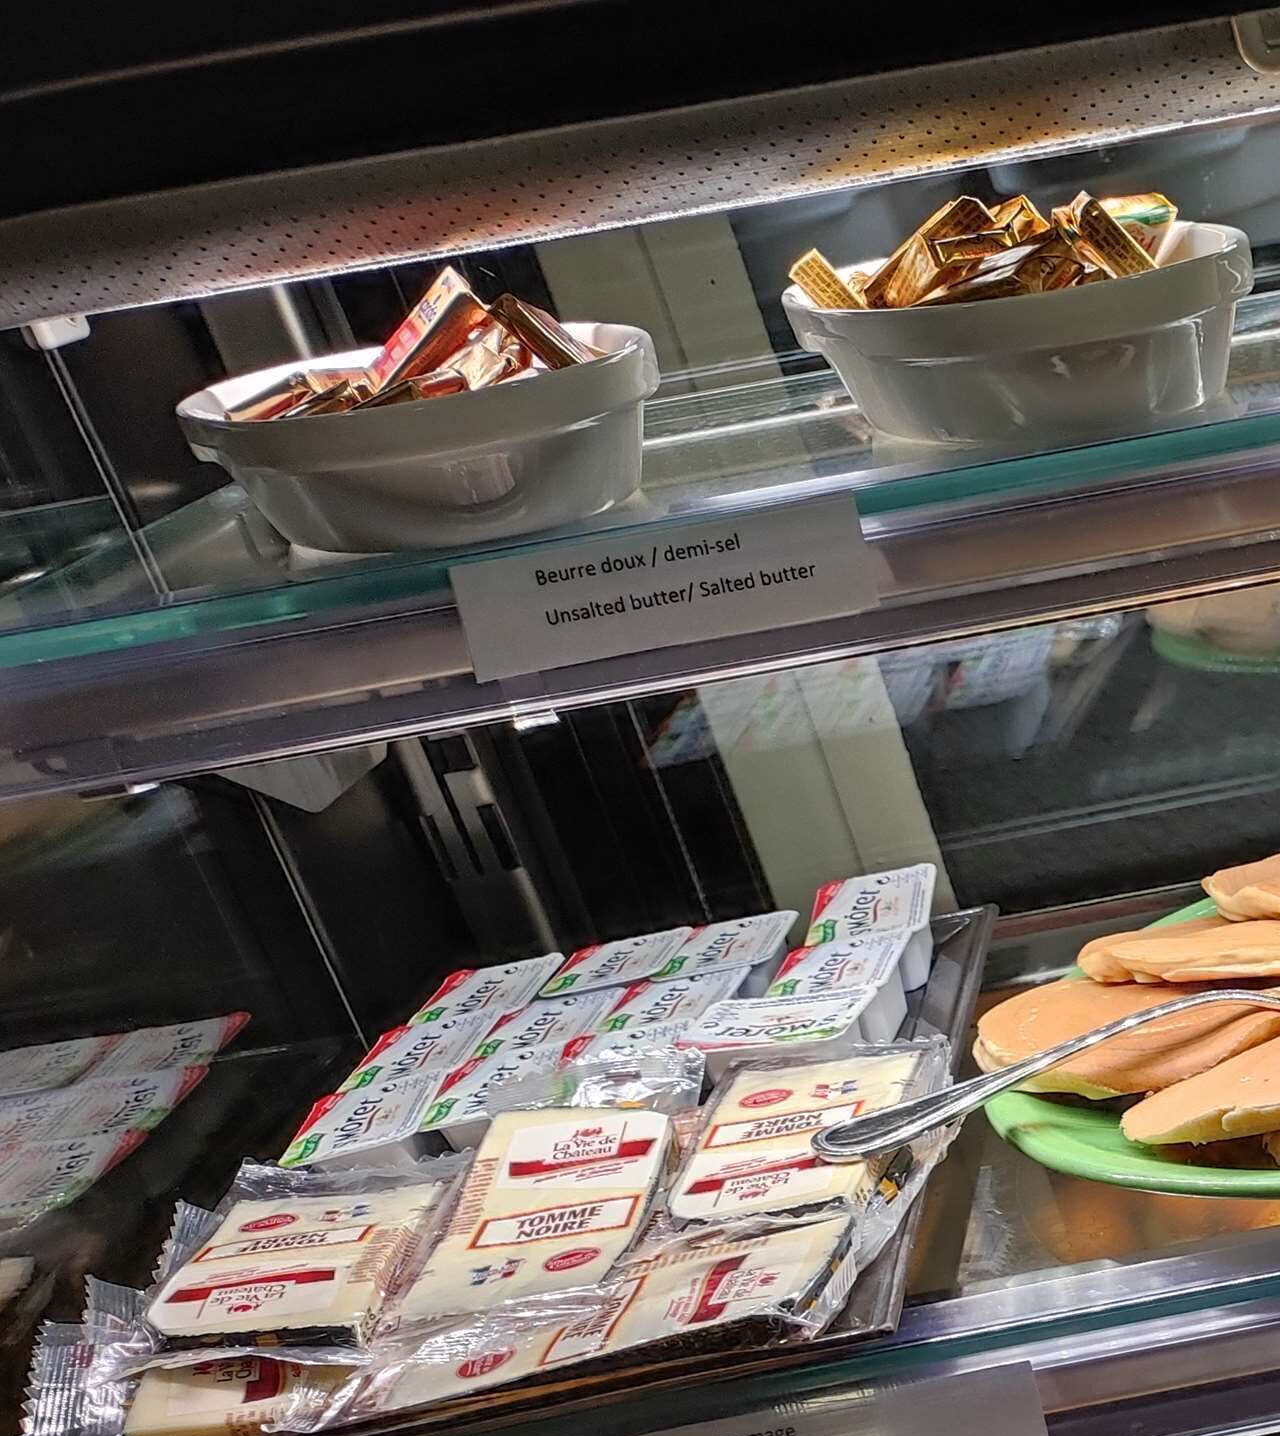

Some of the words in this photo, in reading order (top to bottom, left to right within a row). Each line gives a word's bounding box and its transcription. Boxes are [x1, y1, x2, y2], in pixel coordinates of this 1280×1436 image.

[535, 560, 596, 586] Beurre
[601, 550, 646, 573] doux
[664, 534, 741, 562] demi-sel
[545, 597, 626, 627] Unsalted
[630, 583, 695, 611] butter/
[699, 572, 756, 598] Salted
[760, 562, 817, 587] butter
[553, 1142, 571, 1152] La
[573, 1139, 593, 1149] Vie
[599, 1136, 617, 1145] de
[516, 1205, 603, 1231] TOMME
[516, 1218, 593, 1240] NOIRE
